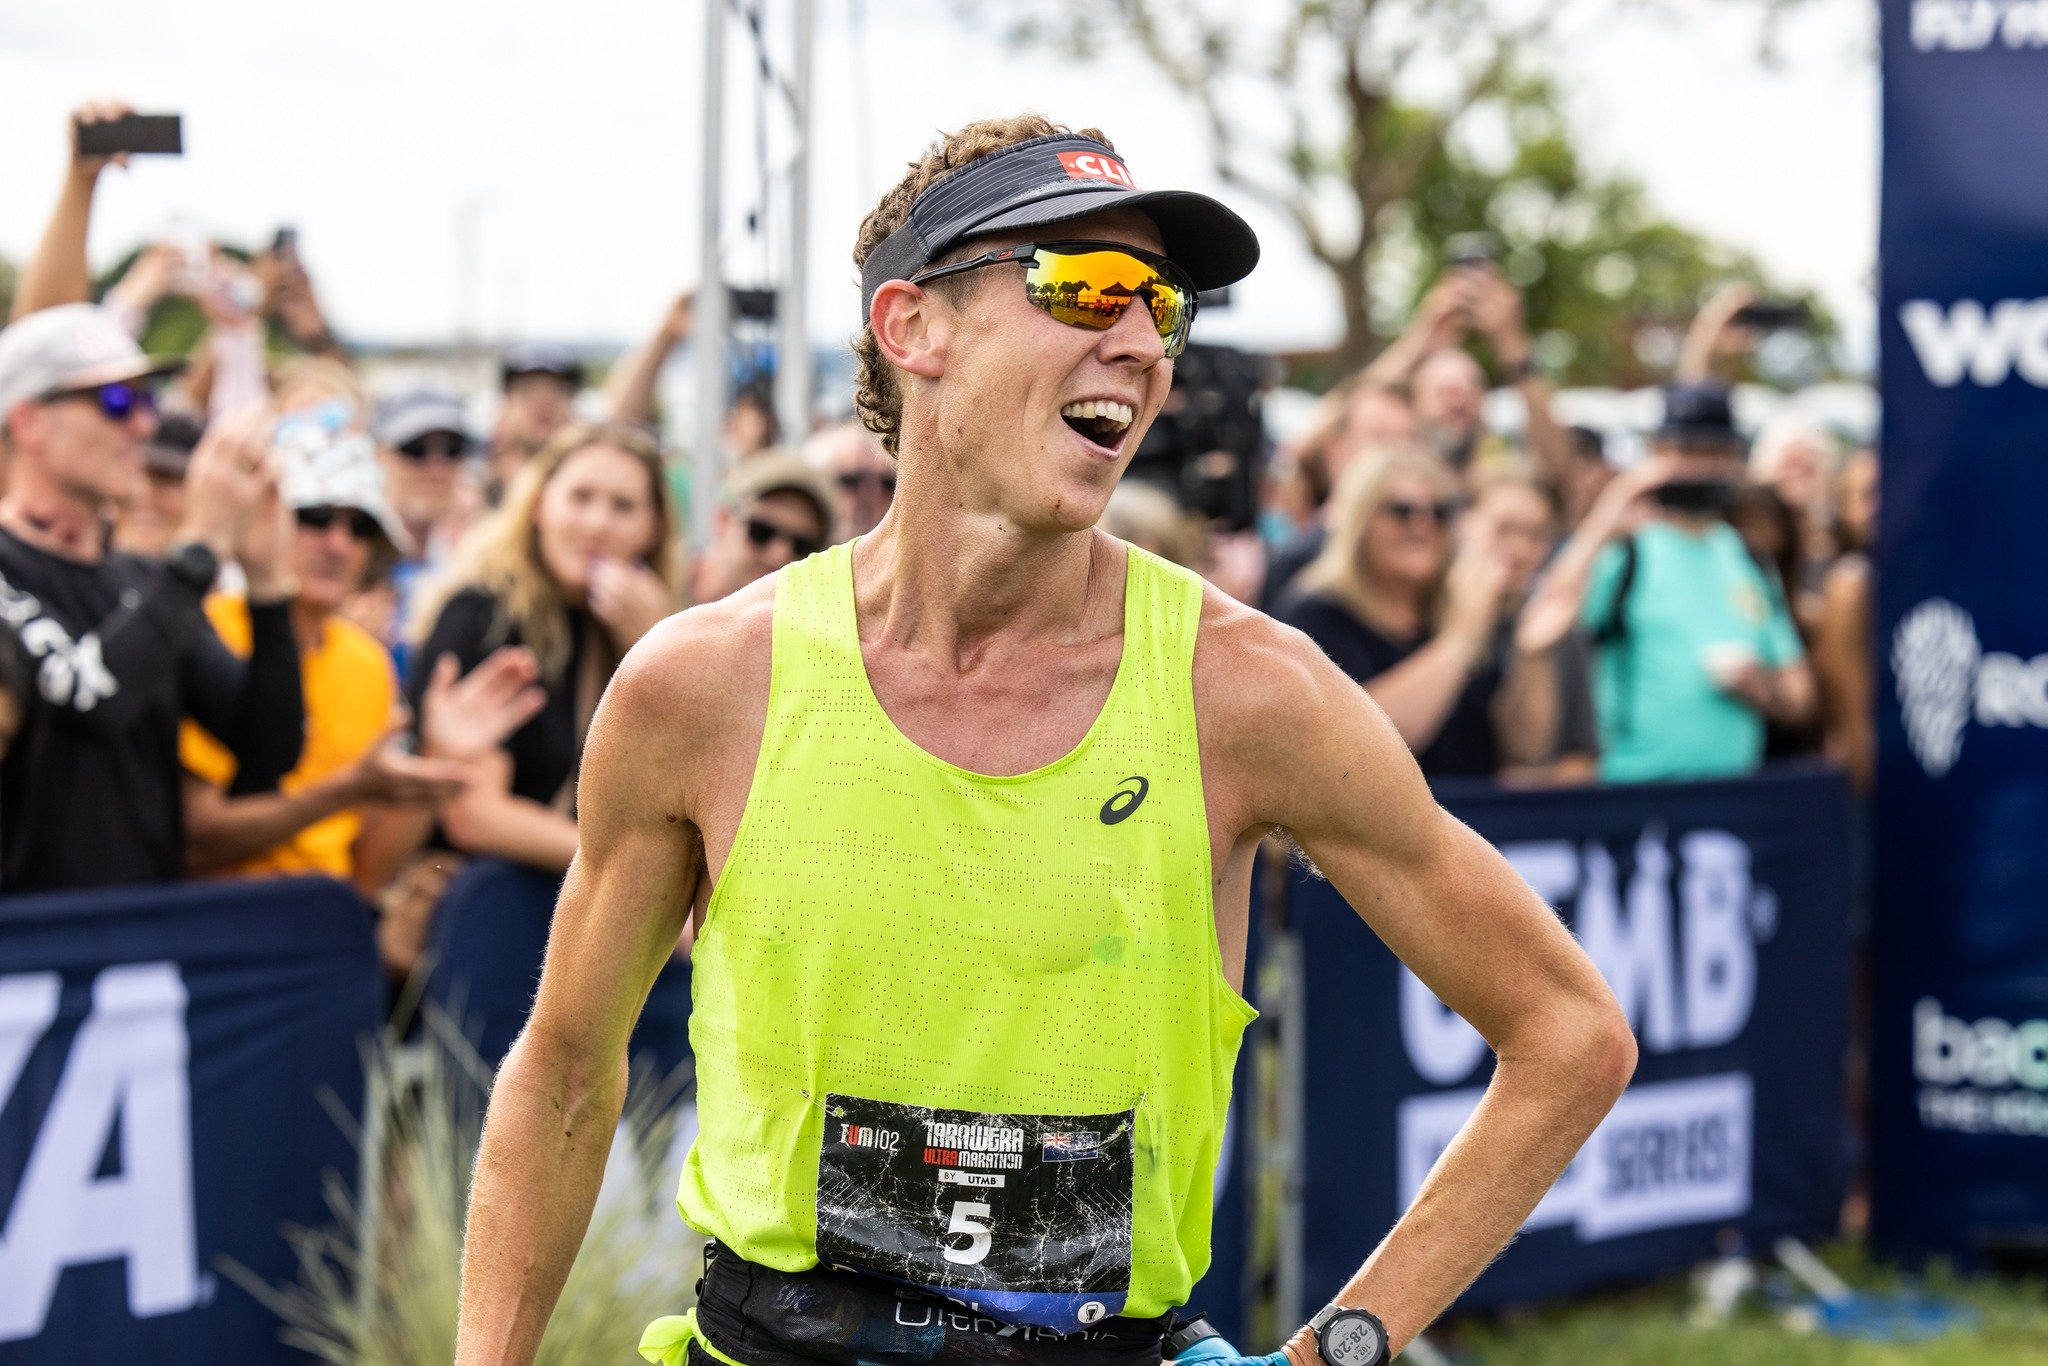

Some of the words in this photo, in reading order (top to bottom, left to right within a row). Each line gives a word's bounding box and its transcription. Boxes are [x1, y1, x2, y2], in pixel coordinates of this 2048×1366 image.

[1075, 155, 1134, 185] CLI
[1399, 820, 1757, 1086] MB
[925, 1122, 1025, 1153] TARAWERA
[944, 1171, 956, 1180] BY
[968, 1174, 997, 1185] UTMB
[943, 1200, 993, 1265] 5
